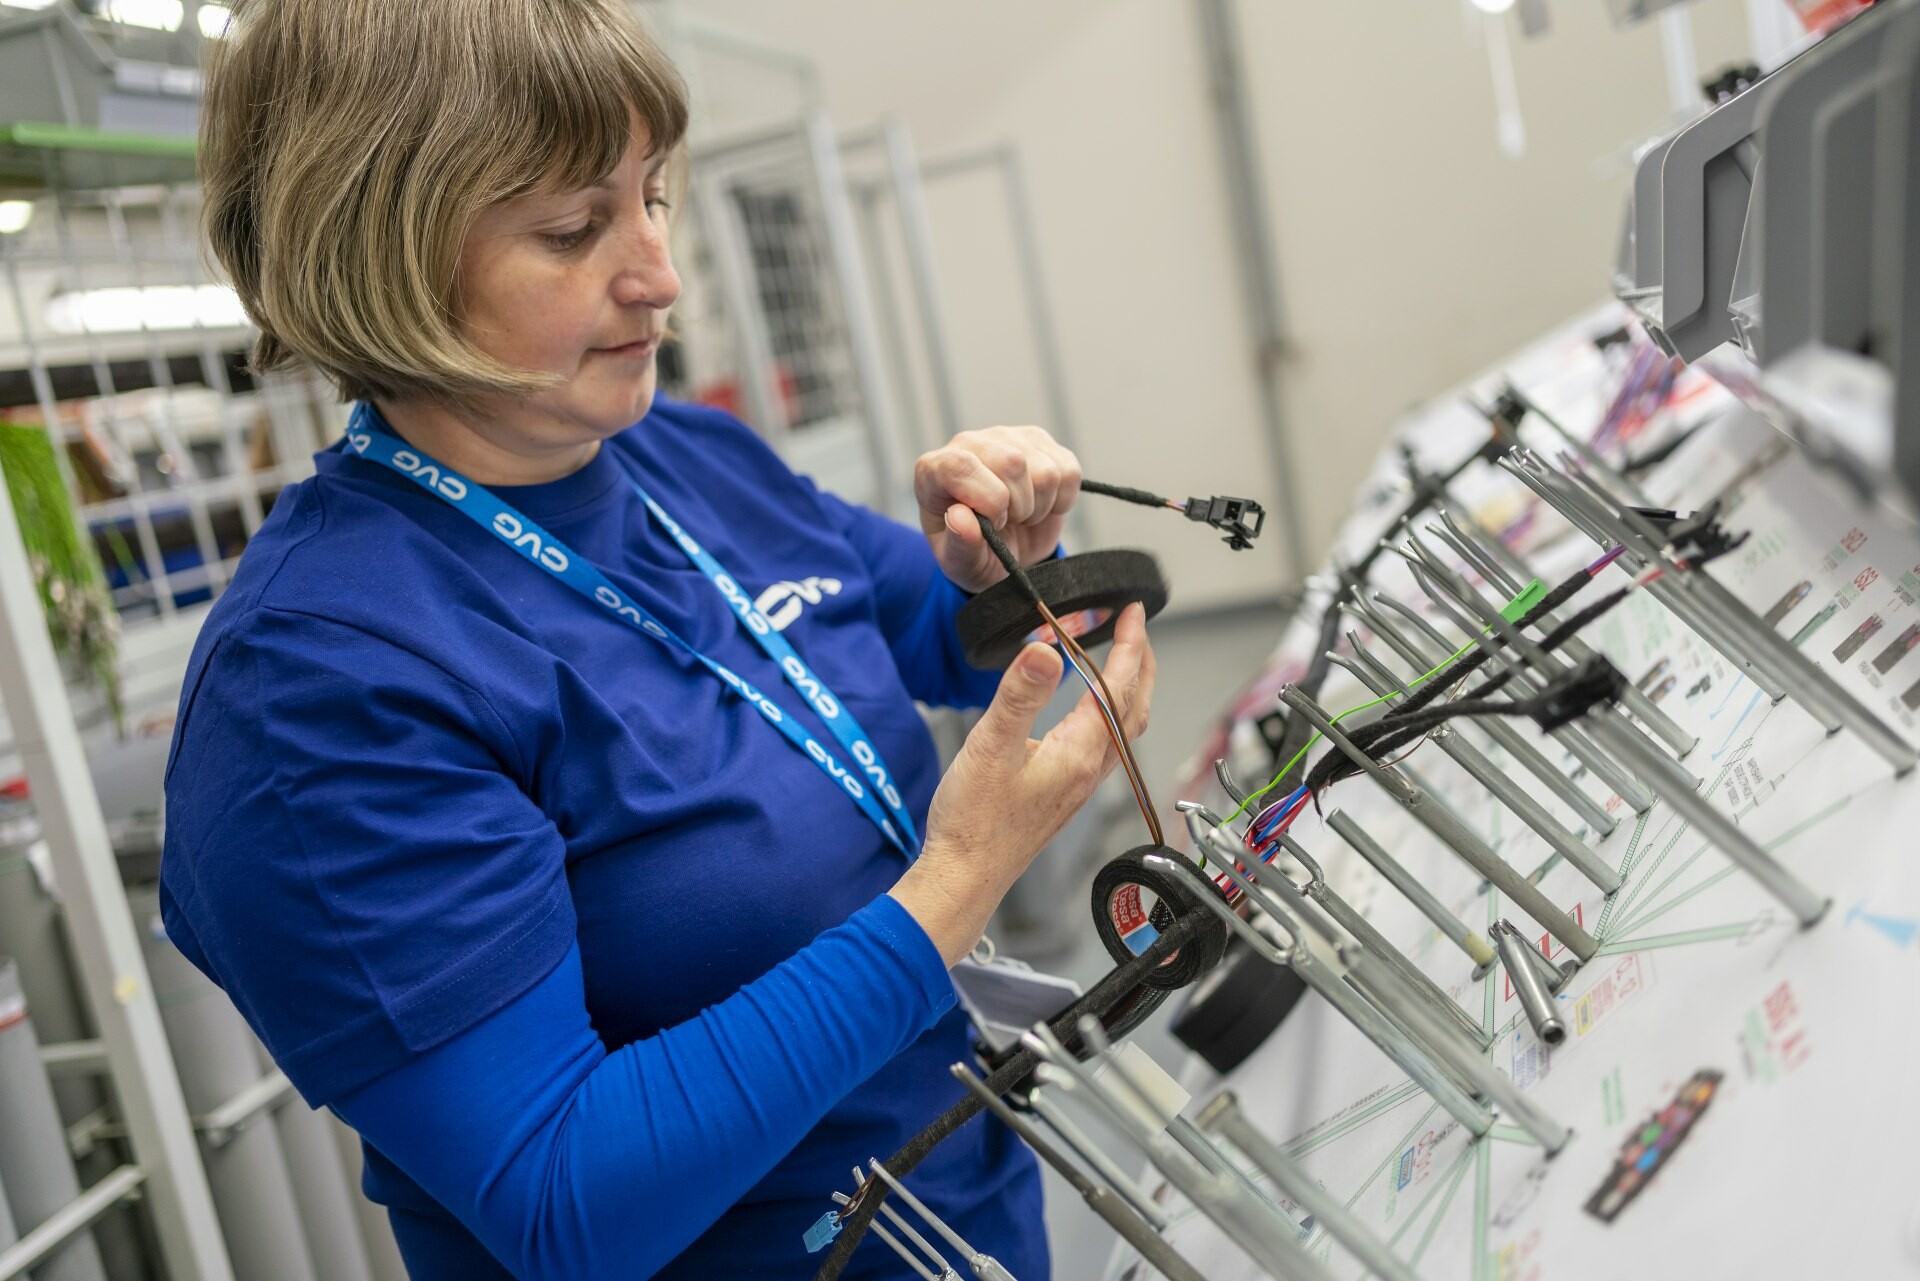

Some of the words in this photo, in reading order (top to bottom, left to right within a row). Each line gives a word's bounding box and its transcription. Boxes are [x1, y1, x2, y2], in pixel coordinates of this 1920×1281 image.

[391, 450, 468, 501] CVG
[492, 512, 569, 573] CVG
[595, 585, 668, 639] CVG
[713, 573, 770, 636] CVG
[717, 666, 783, 723] CVG
[782, 655, 839, 720] CVG
[805, 738, 864, 799] CVG
[851, 739, 902, 810] CVG
[1119, 889, 1130, 923] tesa
